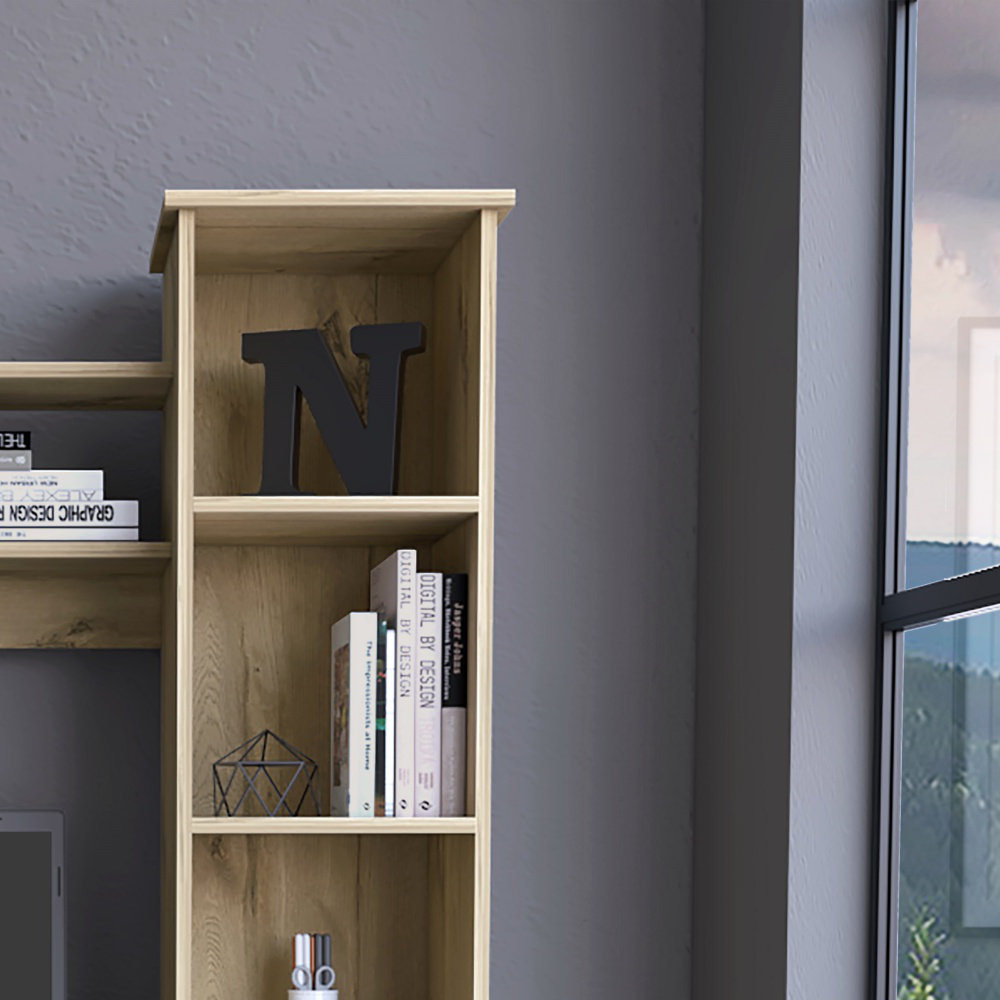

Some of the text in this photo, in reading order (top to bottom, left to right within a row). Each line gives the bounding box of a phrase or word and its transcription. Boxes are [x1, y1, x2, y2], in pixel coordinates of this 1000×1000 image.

[242, 322, 426, 496] N
[5, 433, 26, 448] THE
[23, 490, 96, 502] ALEXEY
[10, 504, 55, 522] DESIGN
[58, 504, 114, 522] GRAPHIC
[400, 551, 411, 697] DIGITAL BY DESIGN
[420, 574, 436, 708] DIGITAL BY DESIGN
[452, 602, 464, 674] Jasper Johns
[366, 732, 372, 740] at
